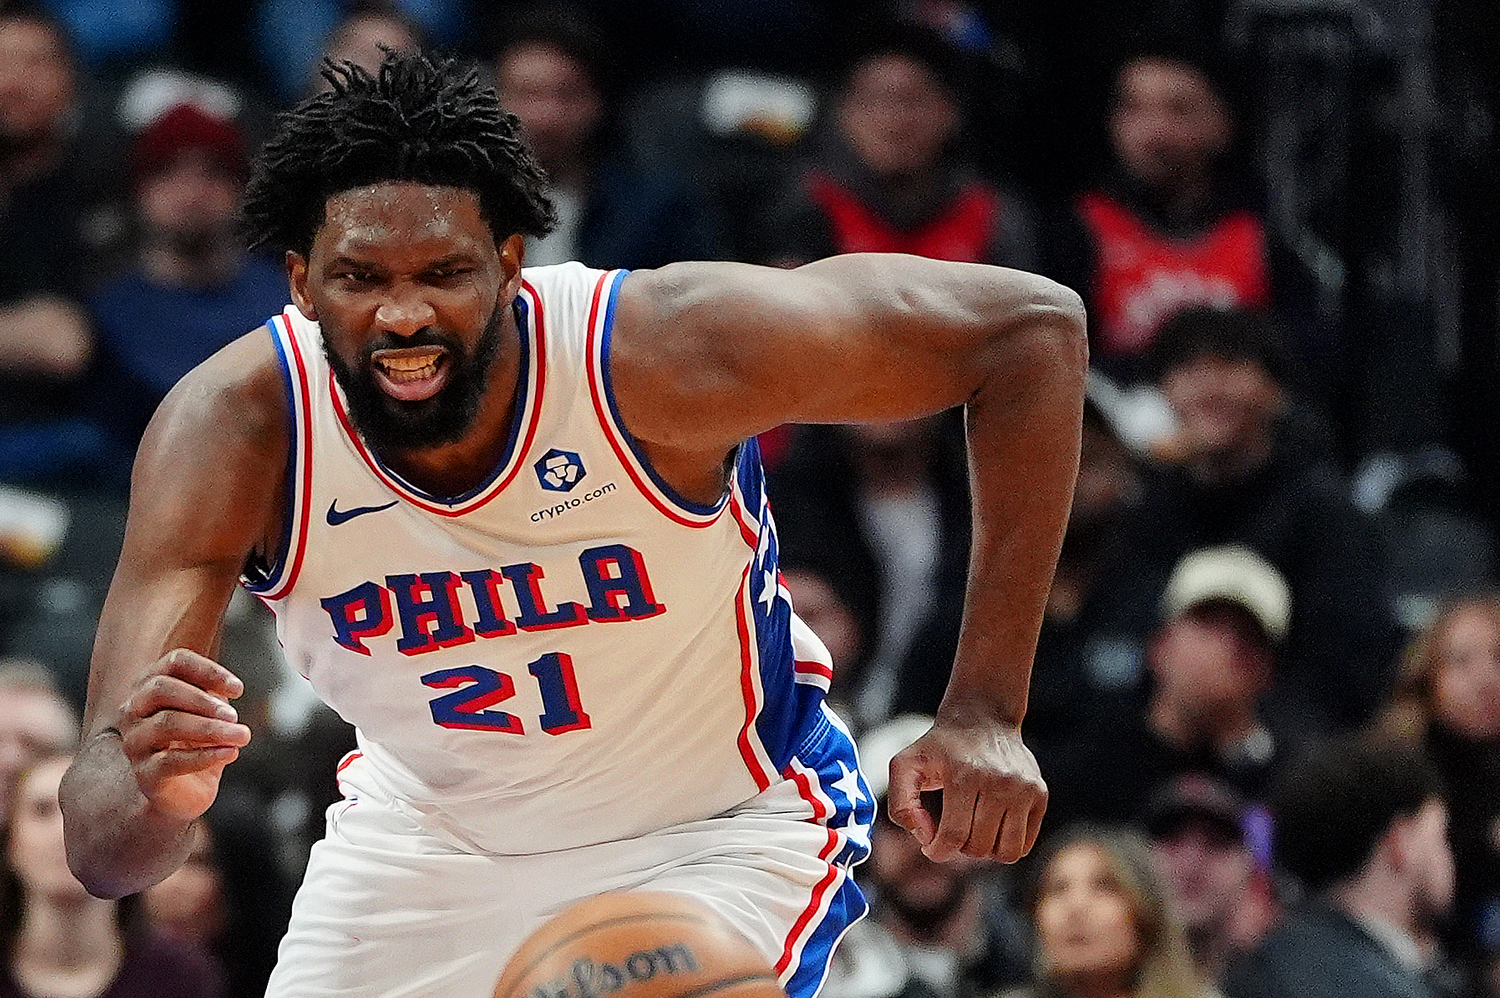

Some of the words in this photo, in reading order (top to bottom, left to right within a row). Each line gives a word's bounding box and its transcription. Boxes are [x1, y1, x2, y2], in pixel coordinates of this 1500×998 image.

[530, 482, 617, 523] crypto.com
[320, 543, 667, 657] PHILA
[420, 652, 592, 736] 21
